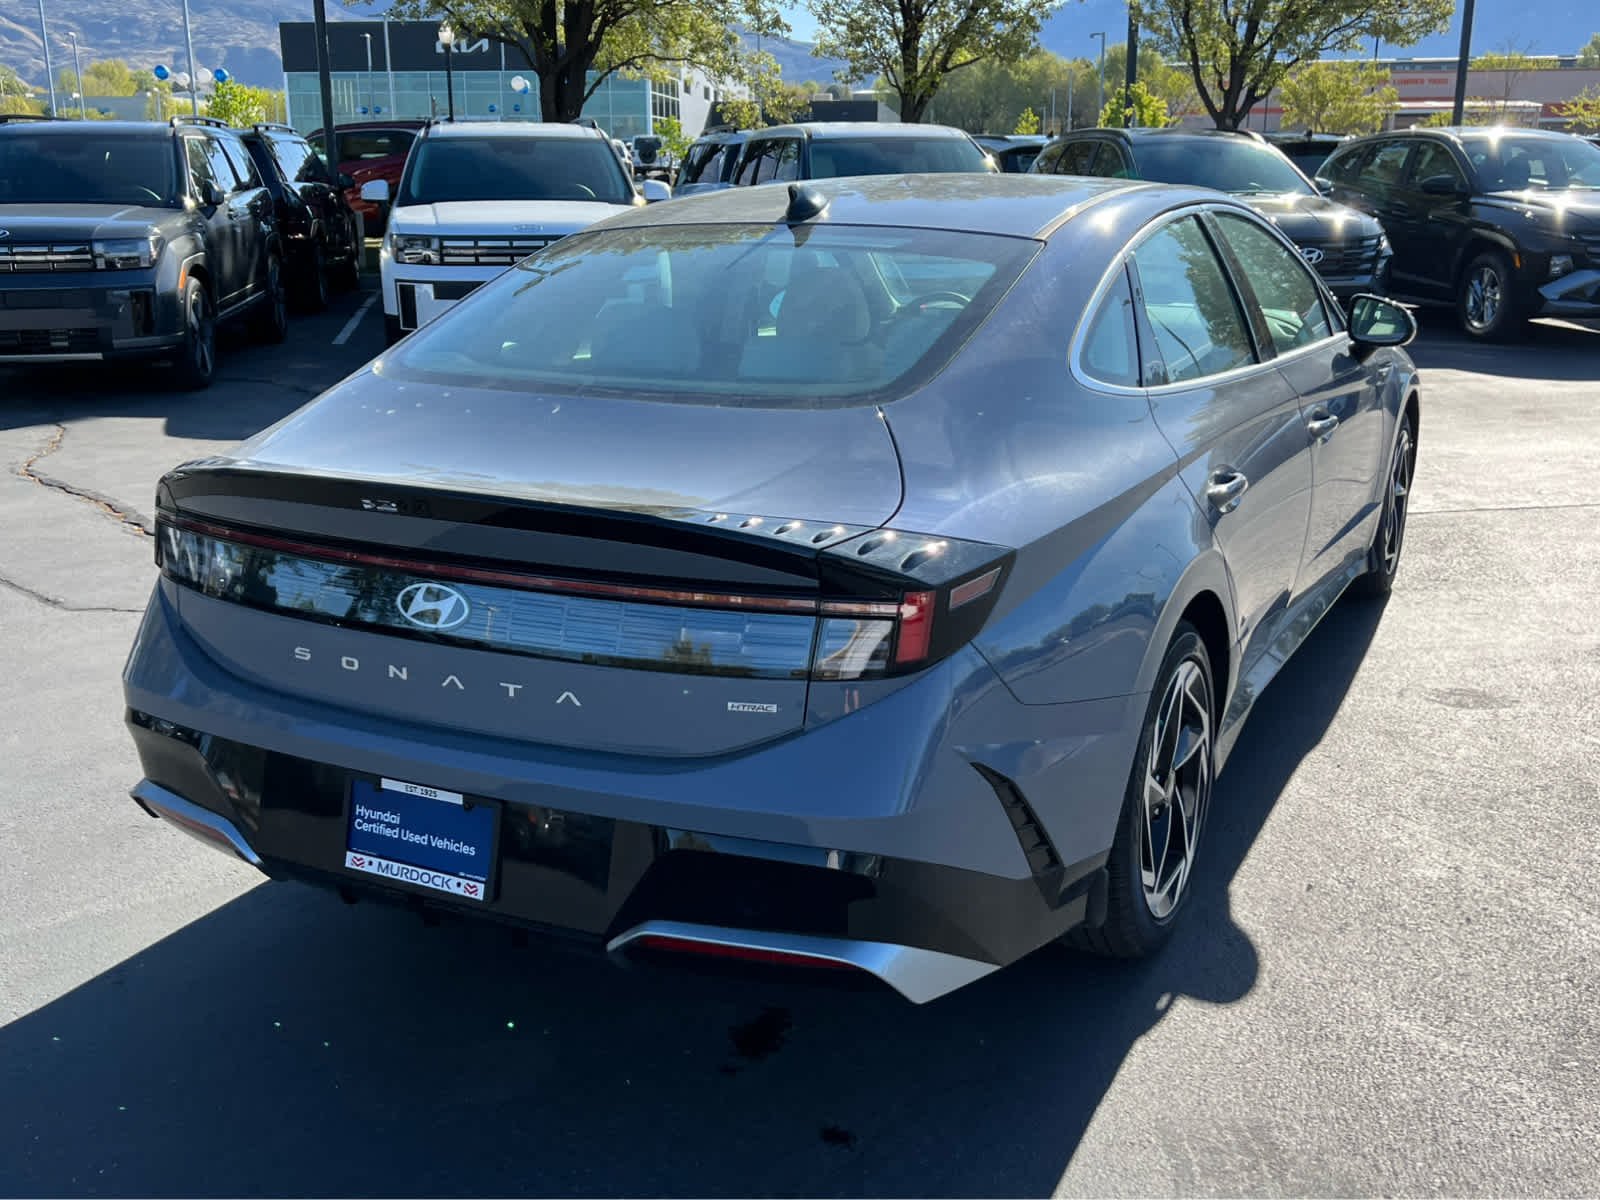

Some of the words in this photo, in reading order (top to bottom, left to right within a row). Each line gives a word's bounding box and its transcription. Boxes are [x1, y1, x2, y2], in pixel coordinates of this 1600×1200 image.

[294, 646, 582, 707] SONATA
[420, 788, 438, 798] 1925
[355, 804, 401, 825] Hyundai
[354, 818, 400, 839] Certified
[401, 829, 429, 846] Used
[430, 835, 476, 856] Vehicles
[376, 861, 452, 890] MURDOCK
